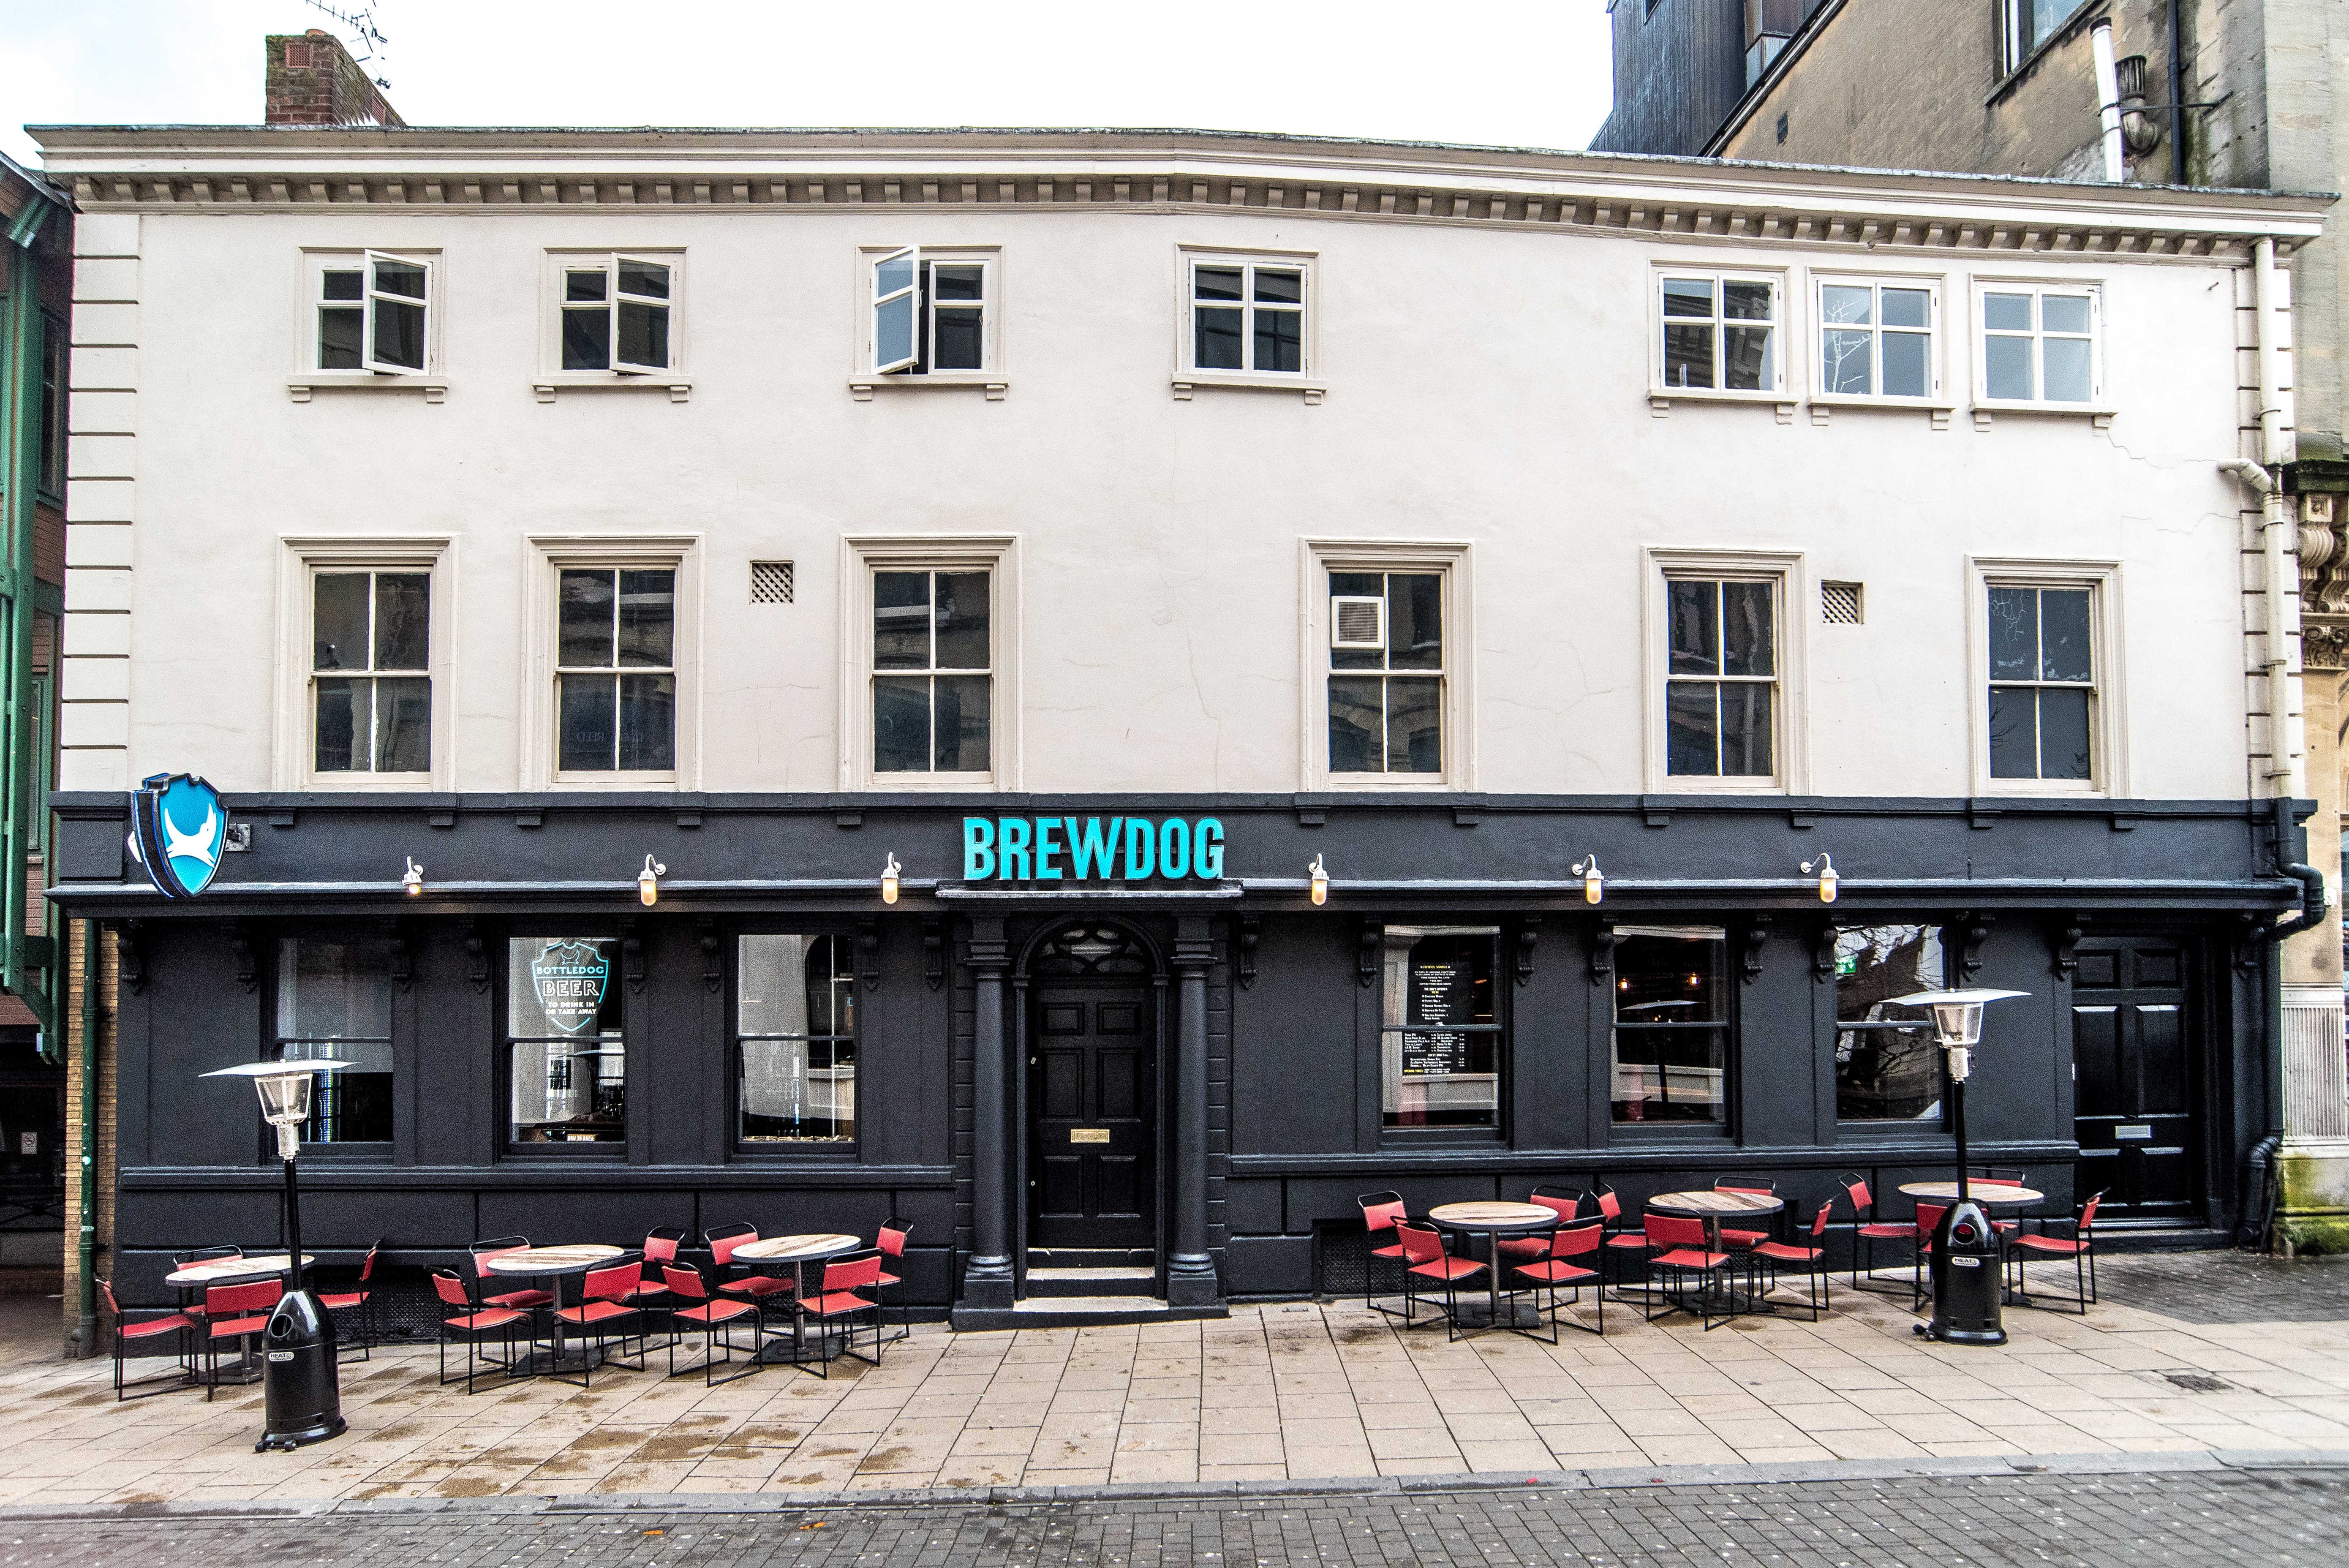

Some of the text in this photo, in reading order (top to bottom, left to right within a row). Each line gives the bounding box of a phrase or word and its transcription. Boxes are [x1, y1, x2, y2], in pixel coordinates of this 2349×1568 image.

[964, 817, 1225, 880] BREWDOG
[537, 966, 604, 975] BOTTLEDOG
[543, 980, 600, 996] BEER
